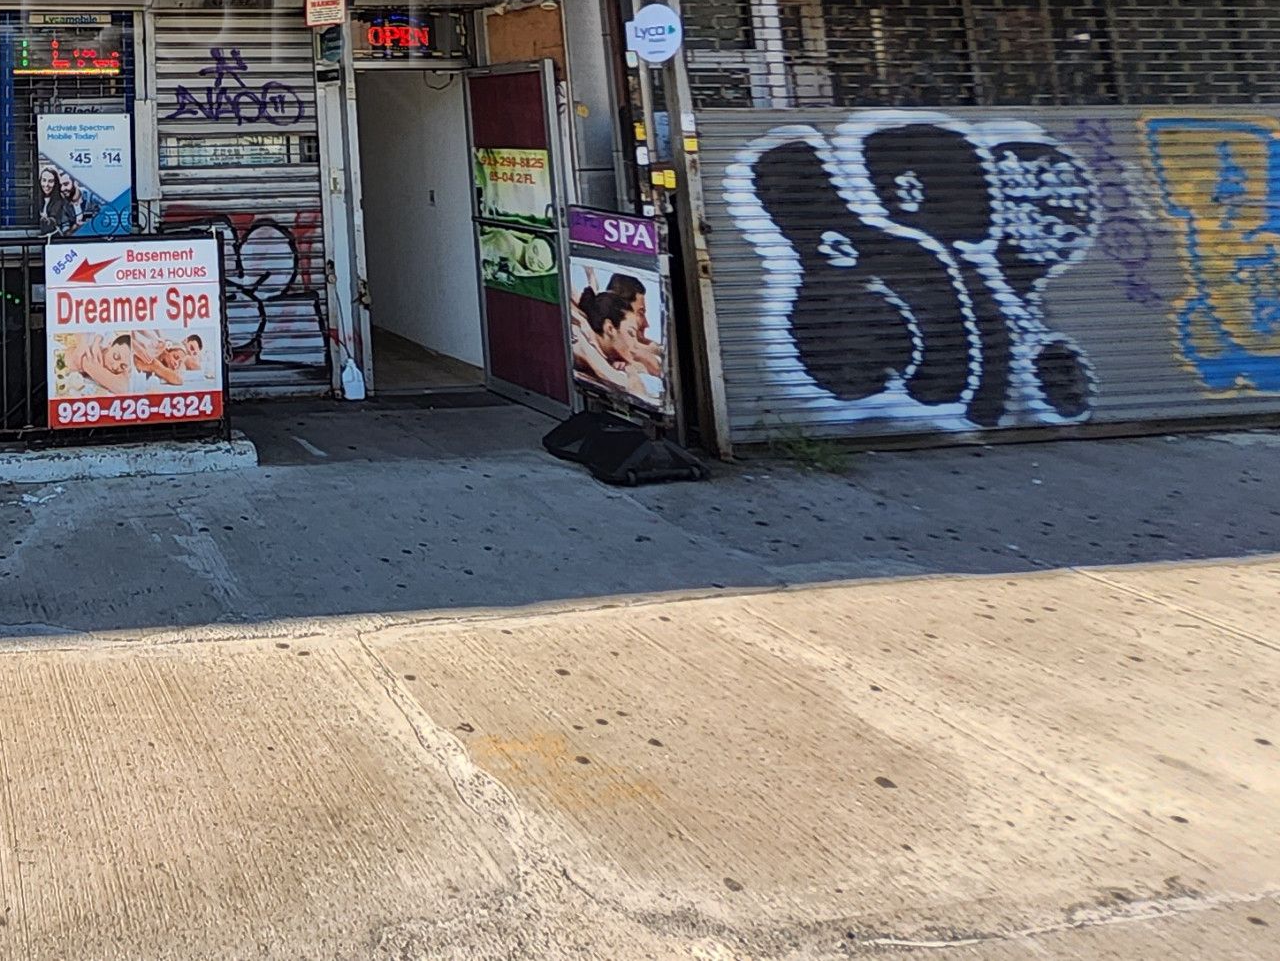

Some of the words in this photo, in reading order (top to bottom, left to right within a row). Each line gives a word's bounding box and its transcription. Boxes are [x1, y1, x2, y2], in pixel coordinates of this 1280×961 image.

[367, 26, 430, 46] OPEN
[46, 124, 78, 132] Activate
[79, 125, 115, 134] Spectrum
[69, 152, 92, 164] $45
[102, 151, 122, 164] $14
[603, 218, 654, 250] SPA
[52, 248, 79, 275] 85-04
[126, 247, 195, 263] Basement
[115, 268, 147, 280] OPEN
[150, 267, 164, 279] 24
[167, 266, 207, 278] HOURS
[56, 290, 158, 325] Dreamer
[166, 287, 211, 328] Spa
[57, 394, 214, 424] 929-426-4324
